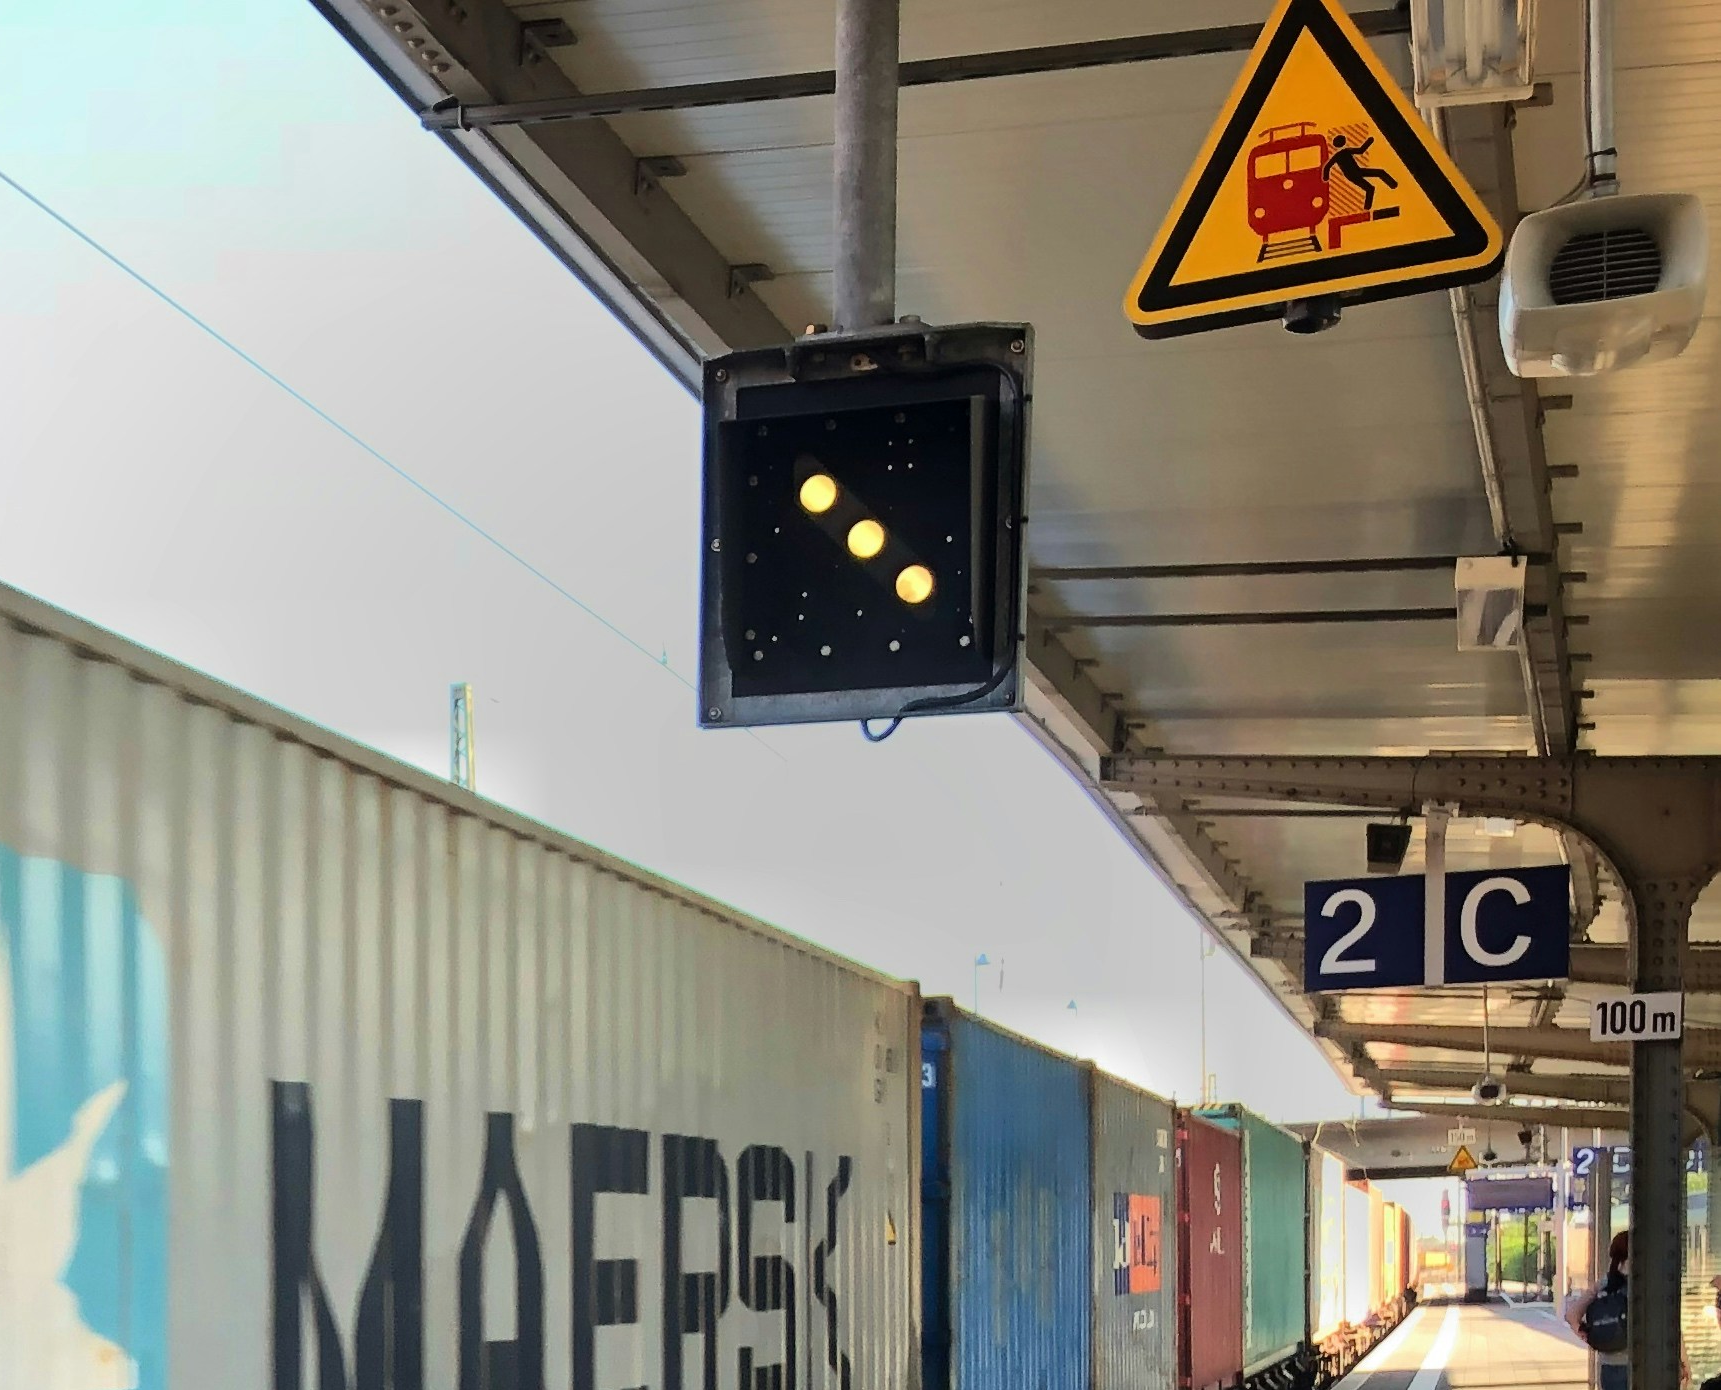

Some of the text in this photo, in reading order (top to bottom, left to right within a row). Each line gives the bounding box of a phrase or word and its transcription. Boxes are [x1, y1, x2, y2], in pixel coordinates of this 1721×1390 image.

[1319, 876, 1532, 975] 2 C
[1596, 1000, 1676, 1036] 100 m
[1576, 1147, 1595, 1175] 2
